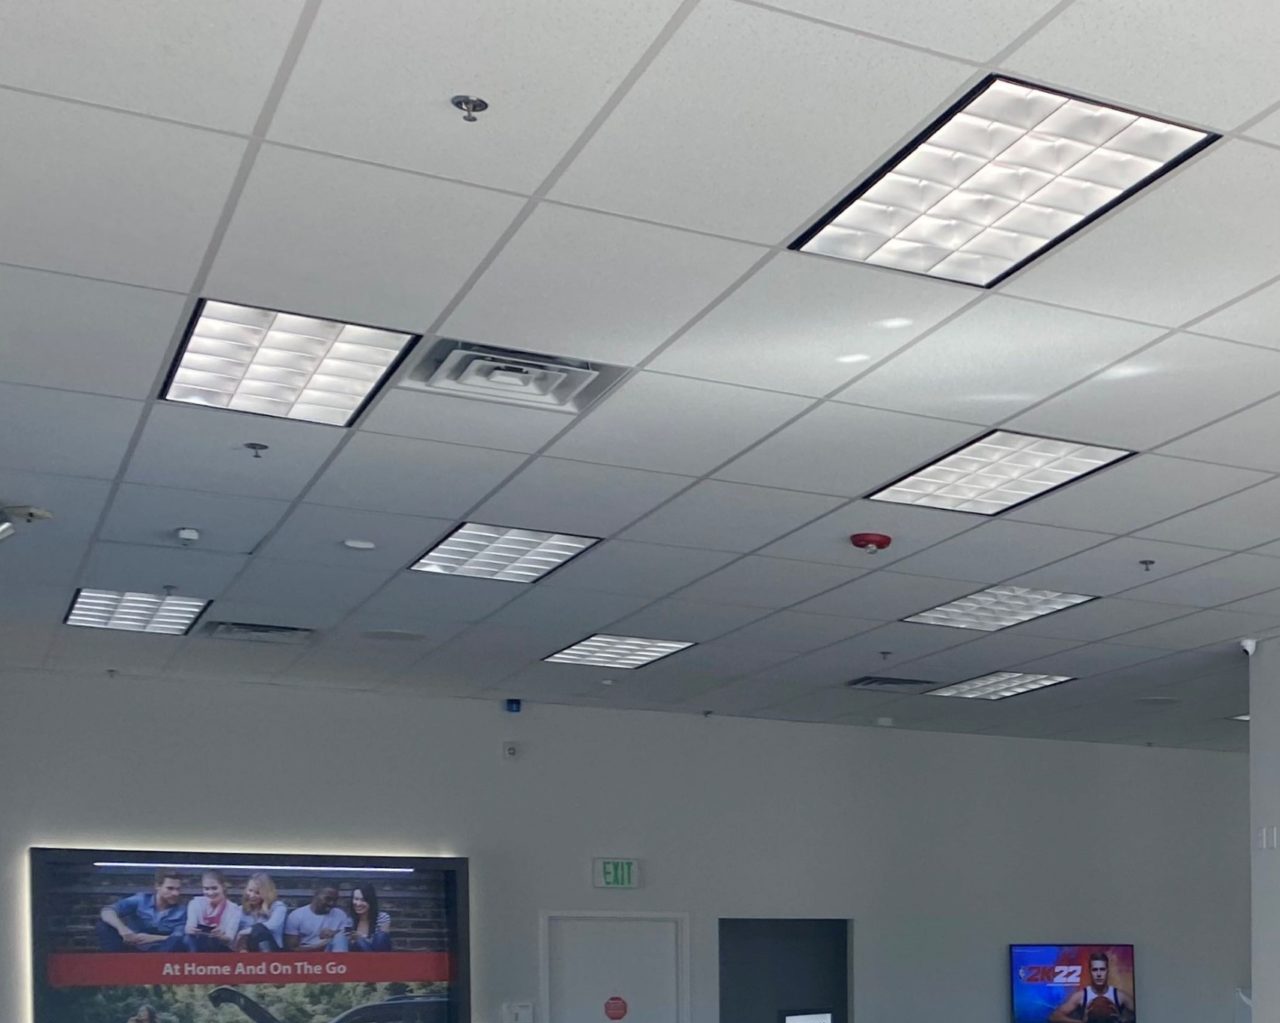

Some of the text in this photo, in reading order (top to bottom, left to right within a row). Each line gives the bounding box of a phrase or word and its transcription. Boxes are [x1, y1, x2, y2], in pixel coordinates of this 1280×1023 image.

[603, 861, 633, 886] EXIT
[162, 962, 347, 975] At Home And On The Go
